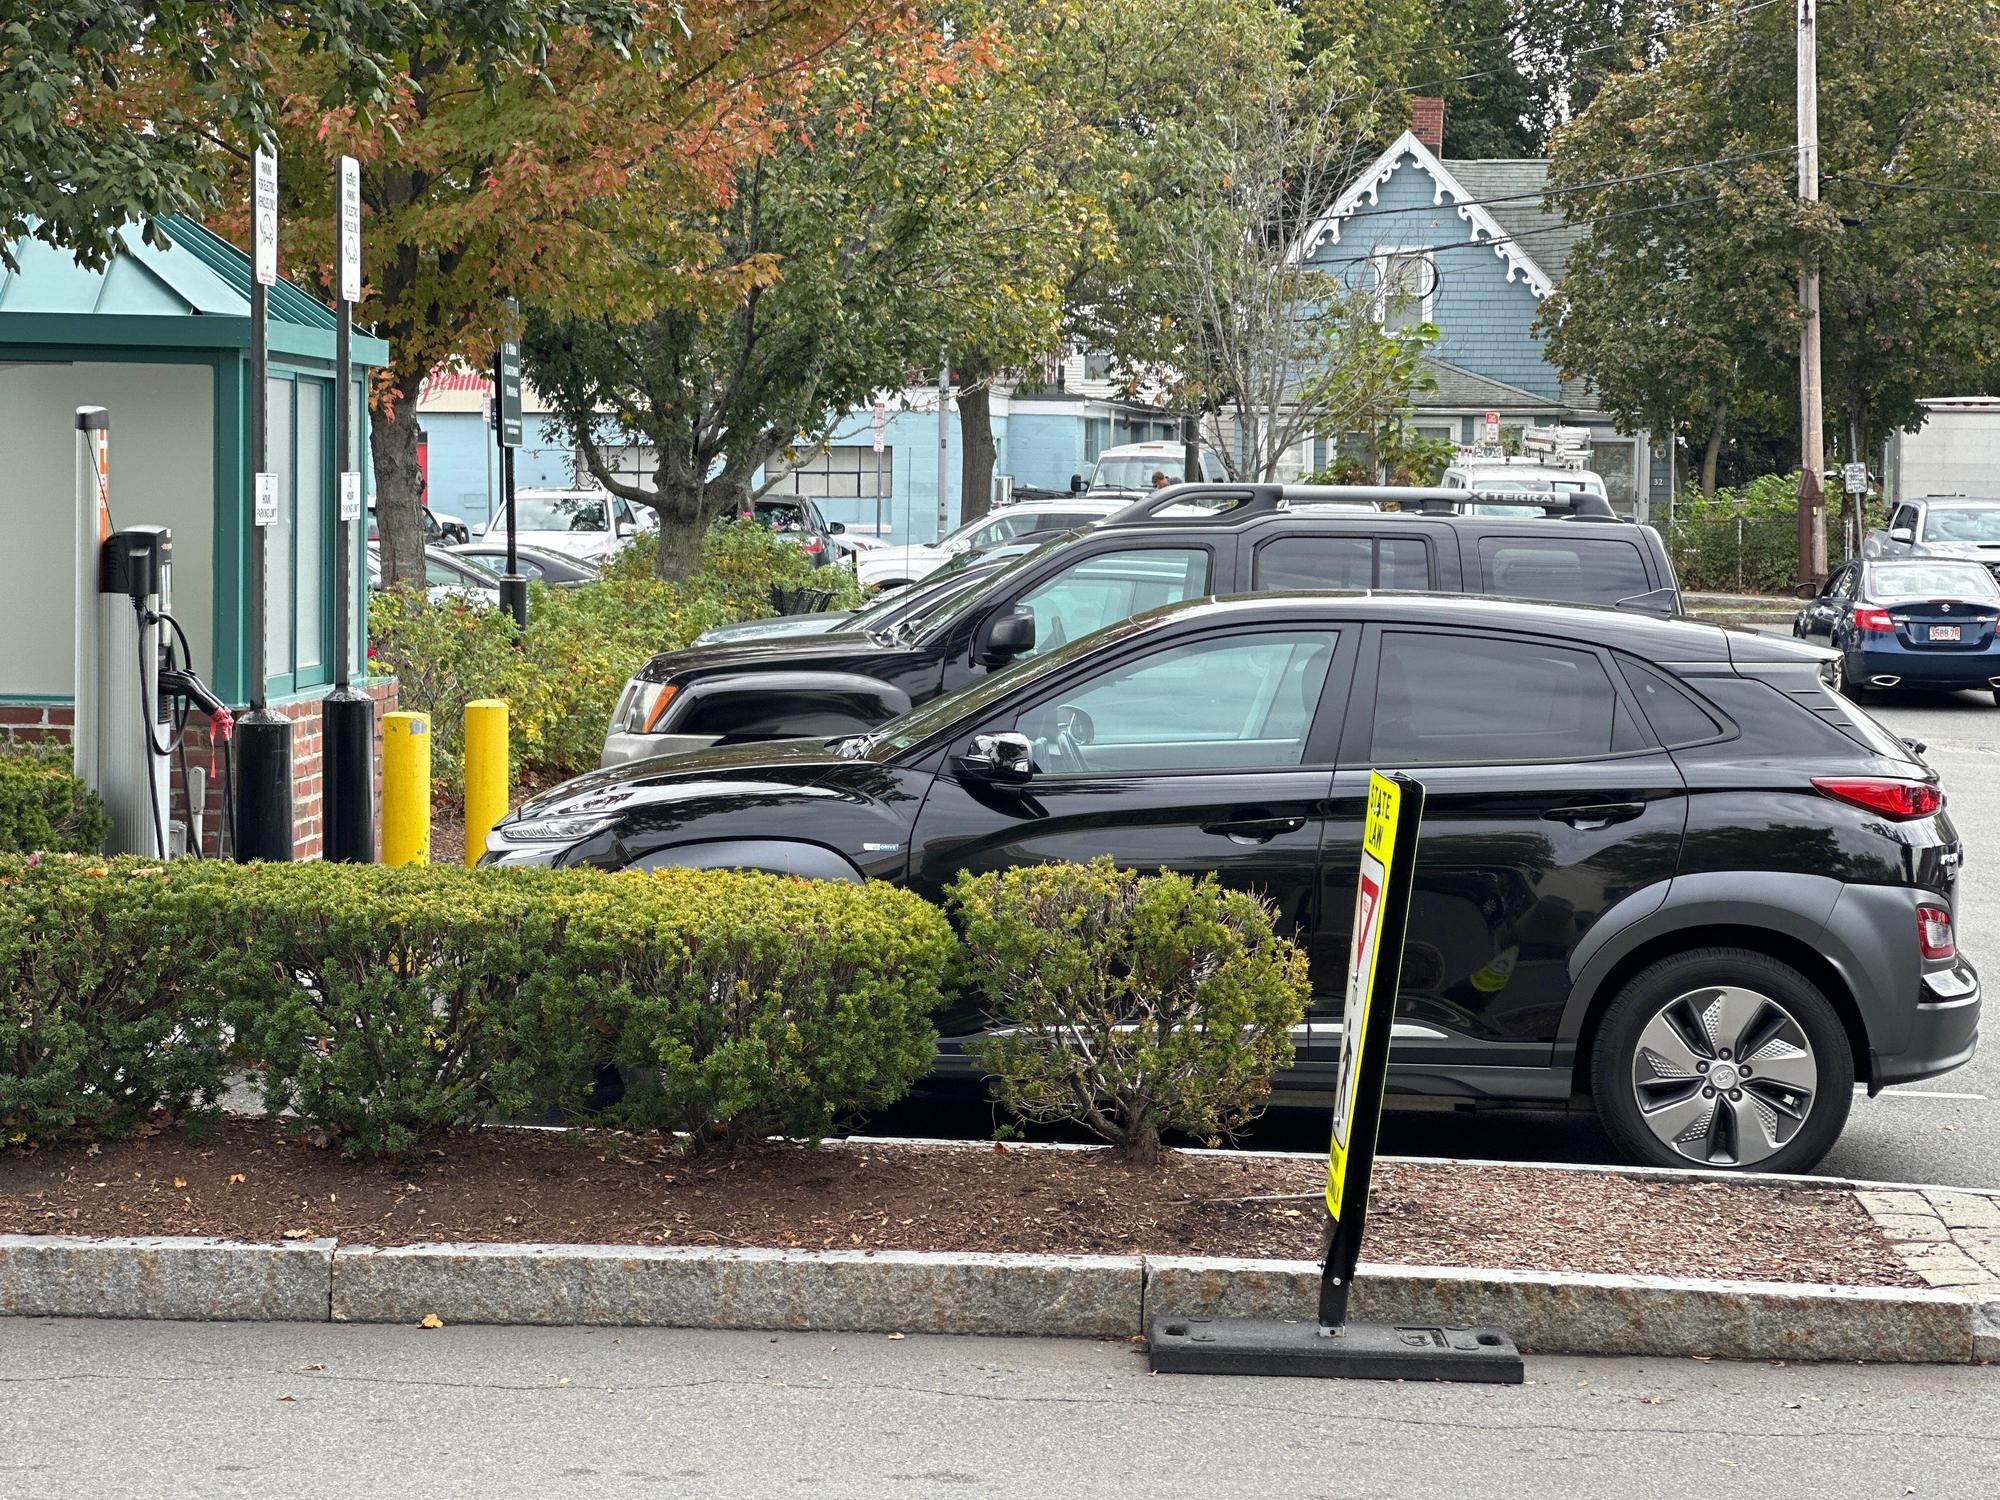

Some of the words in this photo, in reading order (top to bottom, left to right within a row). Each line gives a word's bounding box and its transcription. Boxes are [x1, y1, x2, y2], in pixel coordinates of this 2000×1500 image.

[1653, 478, 1664, 486] 32
[1370, 783, 1392, 820] STATE
[1368, 817, 1384, 851] LAW
